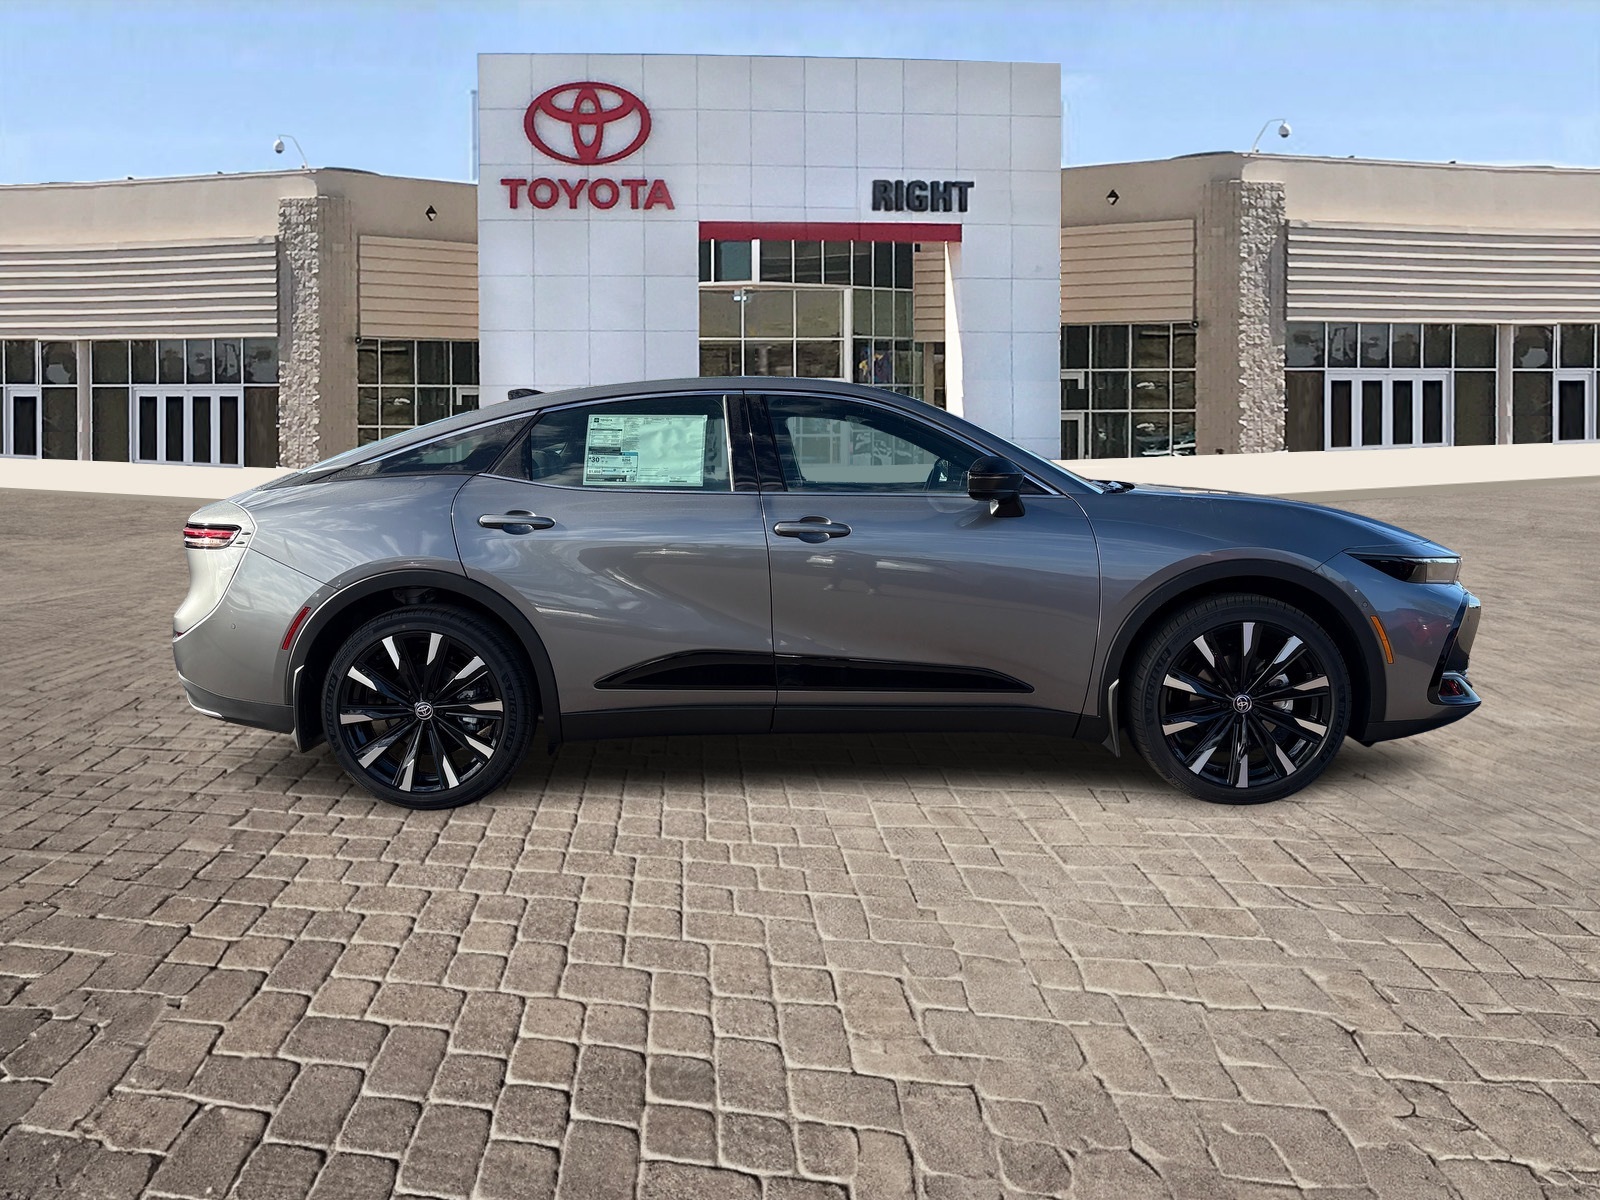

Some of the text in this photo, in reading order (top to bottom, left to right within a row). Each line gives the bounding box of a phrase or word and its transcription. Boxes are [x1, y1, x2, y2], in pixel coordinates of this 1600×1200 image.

[500, 178, 675, 209] TOYOTA
[871, 179, 975, 213] RIGHT
[326, 673, 338, 736] MICHELIN
[503, 688, 516, 751] MICHELIN
